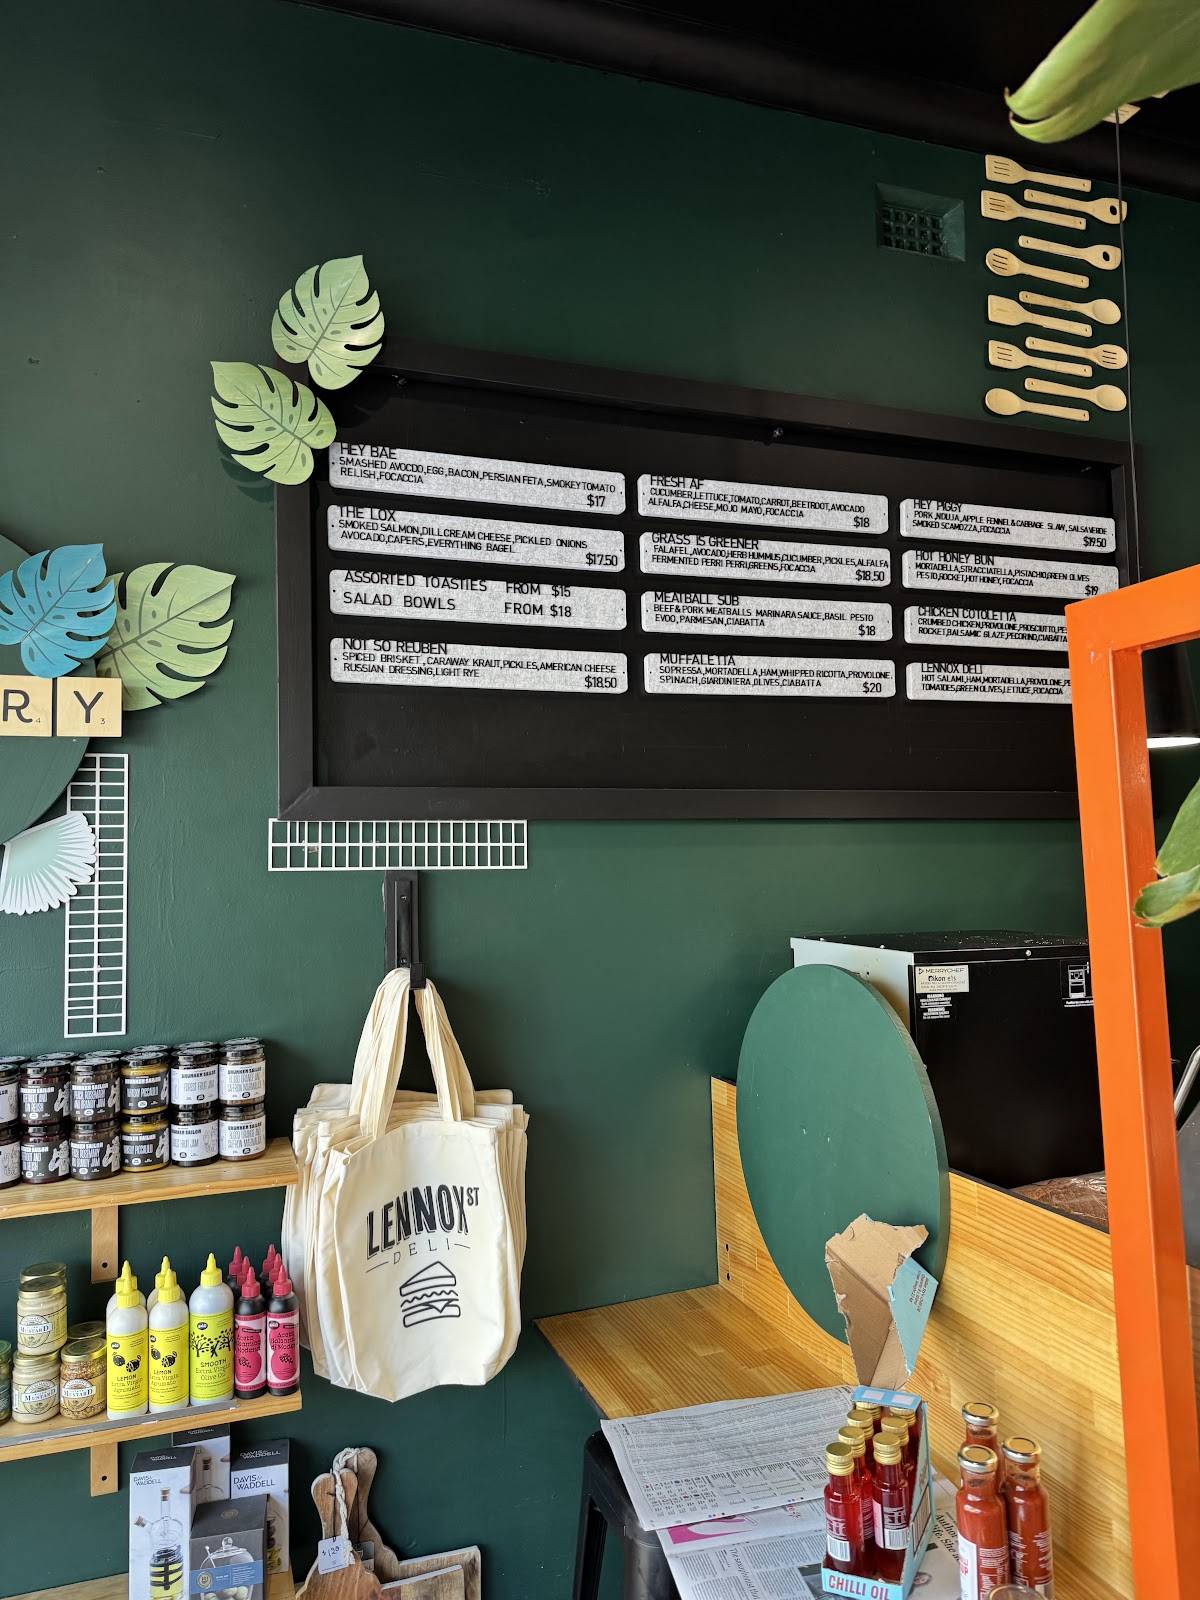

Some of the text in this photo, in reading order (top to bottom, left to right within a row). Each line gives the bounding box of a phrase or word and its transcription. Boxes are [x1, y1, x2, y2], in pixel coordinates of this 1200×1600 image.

[340, 442, 397, 460] HEY BAE
[339, 457, 387, 470] SMASHED
[650, 476, 704, 490] FRESH AF
[587, 494, 606, 508] $17
[913, 499, 963, 513] HEY PIGGY
[340, 506, 397, 521] THE LOX
[853, 515, 870, 529] $18
[912, 520, 939, 529] SMOKED
[338, 520, 379, 531] SMOKED
[556, 539, 588, 549] ONIONS
[651, 532, 759, 551] GRASS IS GREENER
[486, 543, 516, 553] BAGEL
[652, 555, 699, 566] FERMENTED
[701, 559, 724, 568] PERRI
[915, 551, 995, 566] HOT HONEY BUN
[855, 569, 885, 582] $18.50
[344, 571, 571, 598] ASSORTED TOASTIES FROM $15
[1084, 584, 1099, 597] $19
[343, 591, 572, 617] SALAD BOWLS FROM $18
[654, 591, 740, 606] MEATBALL SUB
[682, 605, 704, 614] PORK
[705, 607, 752, 617] MEATBALLS
[849, 613, 874, 622] PESTO
[917, 606, 1017, 621] CHICKEN COTOLETTA
[917, 618, 952, 626] CRUMBED
[858, 624, 876, 637] $18
[342, 638, 448, 655] NOT SO REUBEN
[342, 651, 376, 662] SPICED
[584, 664, 617, 674] CHEESE
[660, 653, 736, 666] MUFFALETTA
[343, 663, 384, 673] RUSSIAN
[463, 668, 481, 678] RYE
[921, 662, 983, 674] LENNOX DELI
[584, 674, 617, 689] $18.50
[862, 682, 882, 694] $20
[366, 1184, 480, 1260] LENNOX ST
[393, 1238, 450, 1265] DELI
[200, 1359, 227, 1368] SMOOTH
[116, 1374, 137, 1382] LEMON
[24, 1388, 57, 1401] MUSTARD
[63, 1388, 93, 1398] MUSTARD
[135, 1479, 162, 1487] WADDELL
[233, 1474, 257, 1485] DAVIS
[236, 1479, 275, 1490] WADDELL
[828, 1574, 890, 1600] CHILLI OIL
